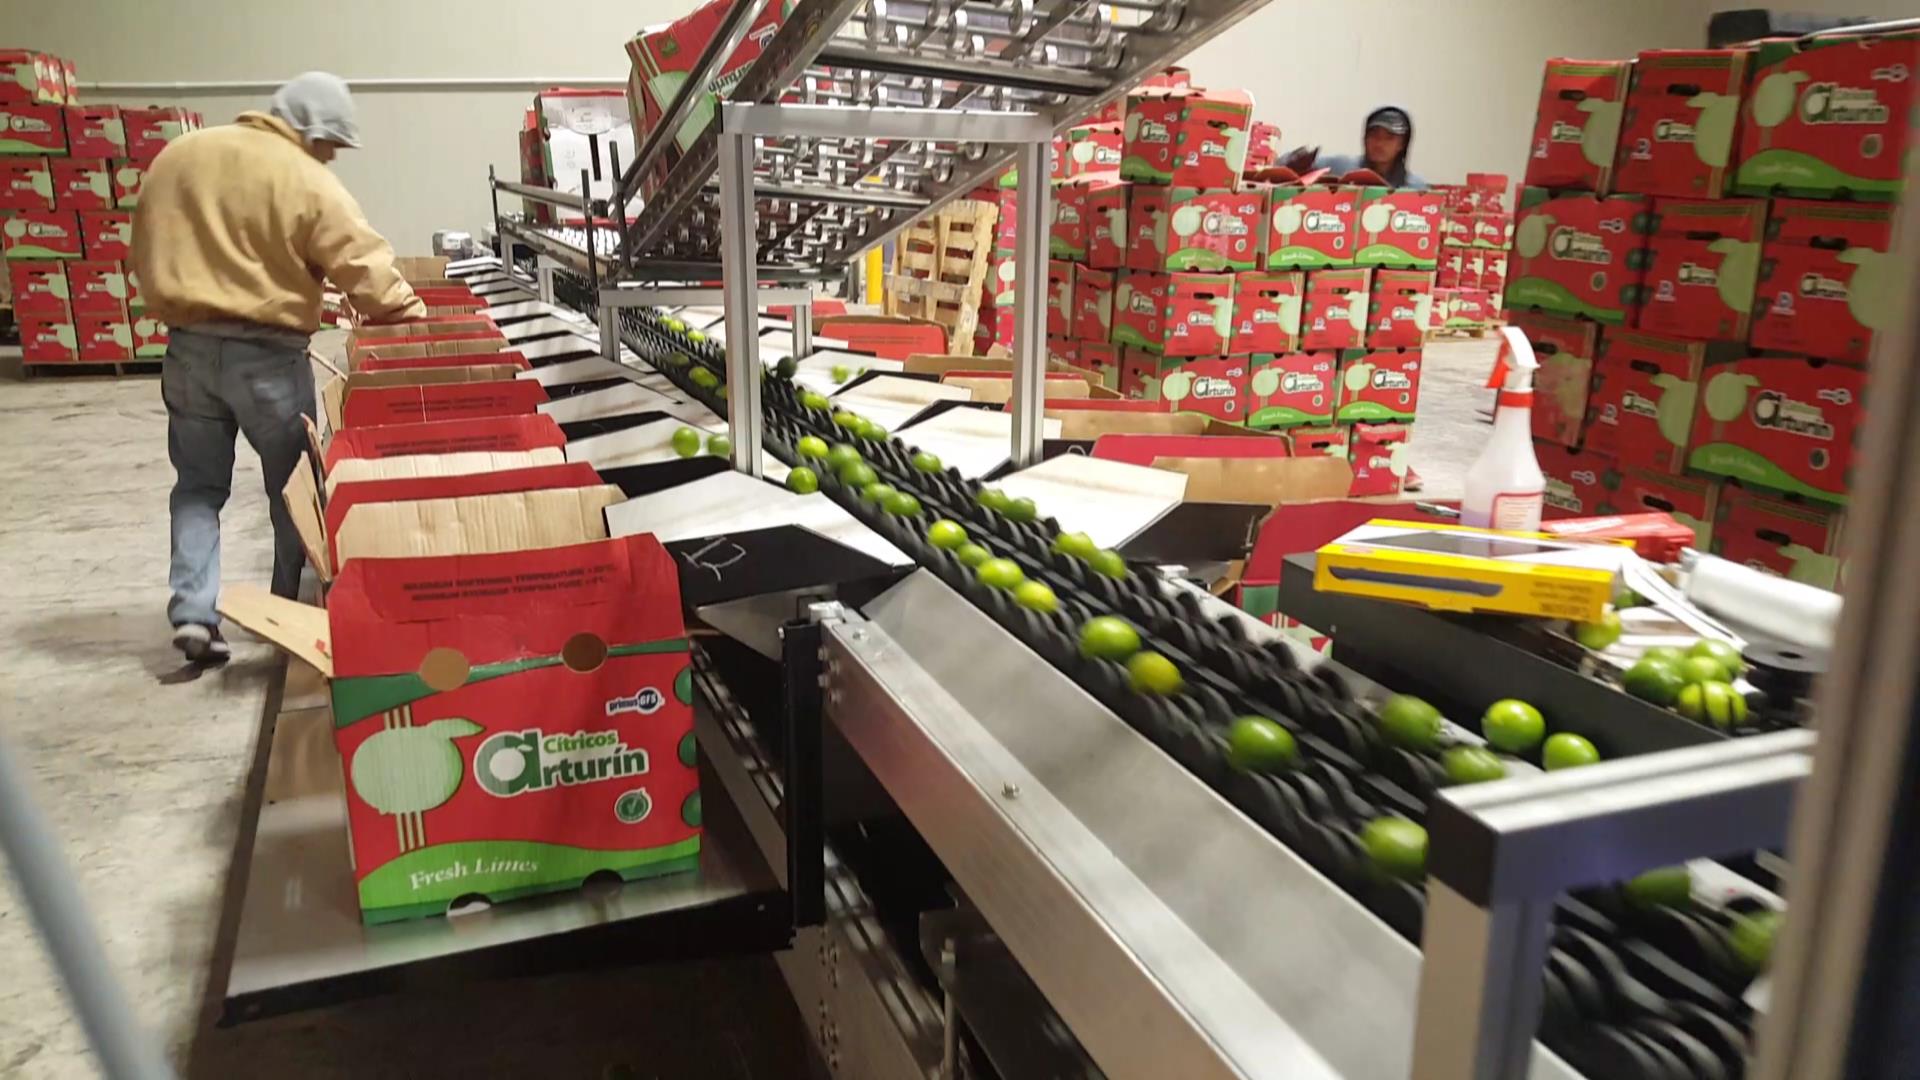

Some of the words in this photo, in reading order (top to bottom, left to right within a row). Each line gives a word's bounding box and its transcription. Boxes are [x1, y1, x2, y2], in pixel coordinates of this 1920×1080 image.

[544, 731, 617, 754] Cítricos
[410, 860, 469, 890] Fresh
[474, 857, 539, 874] Limes
